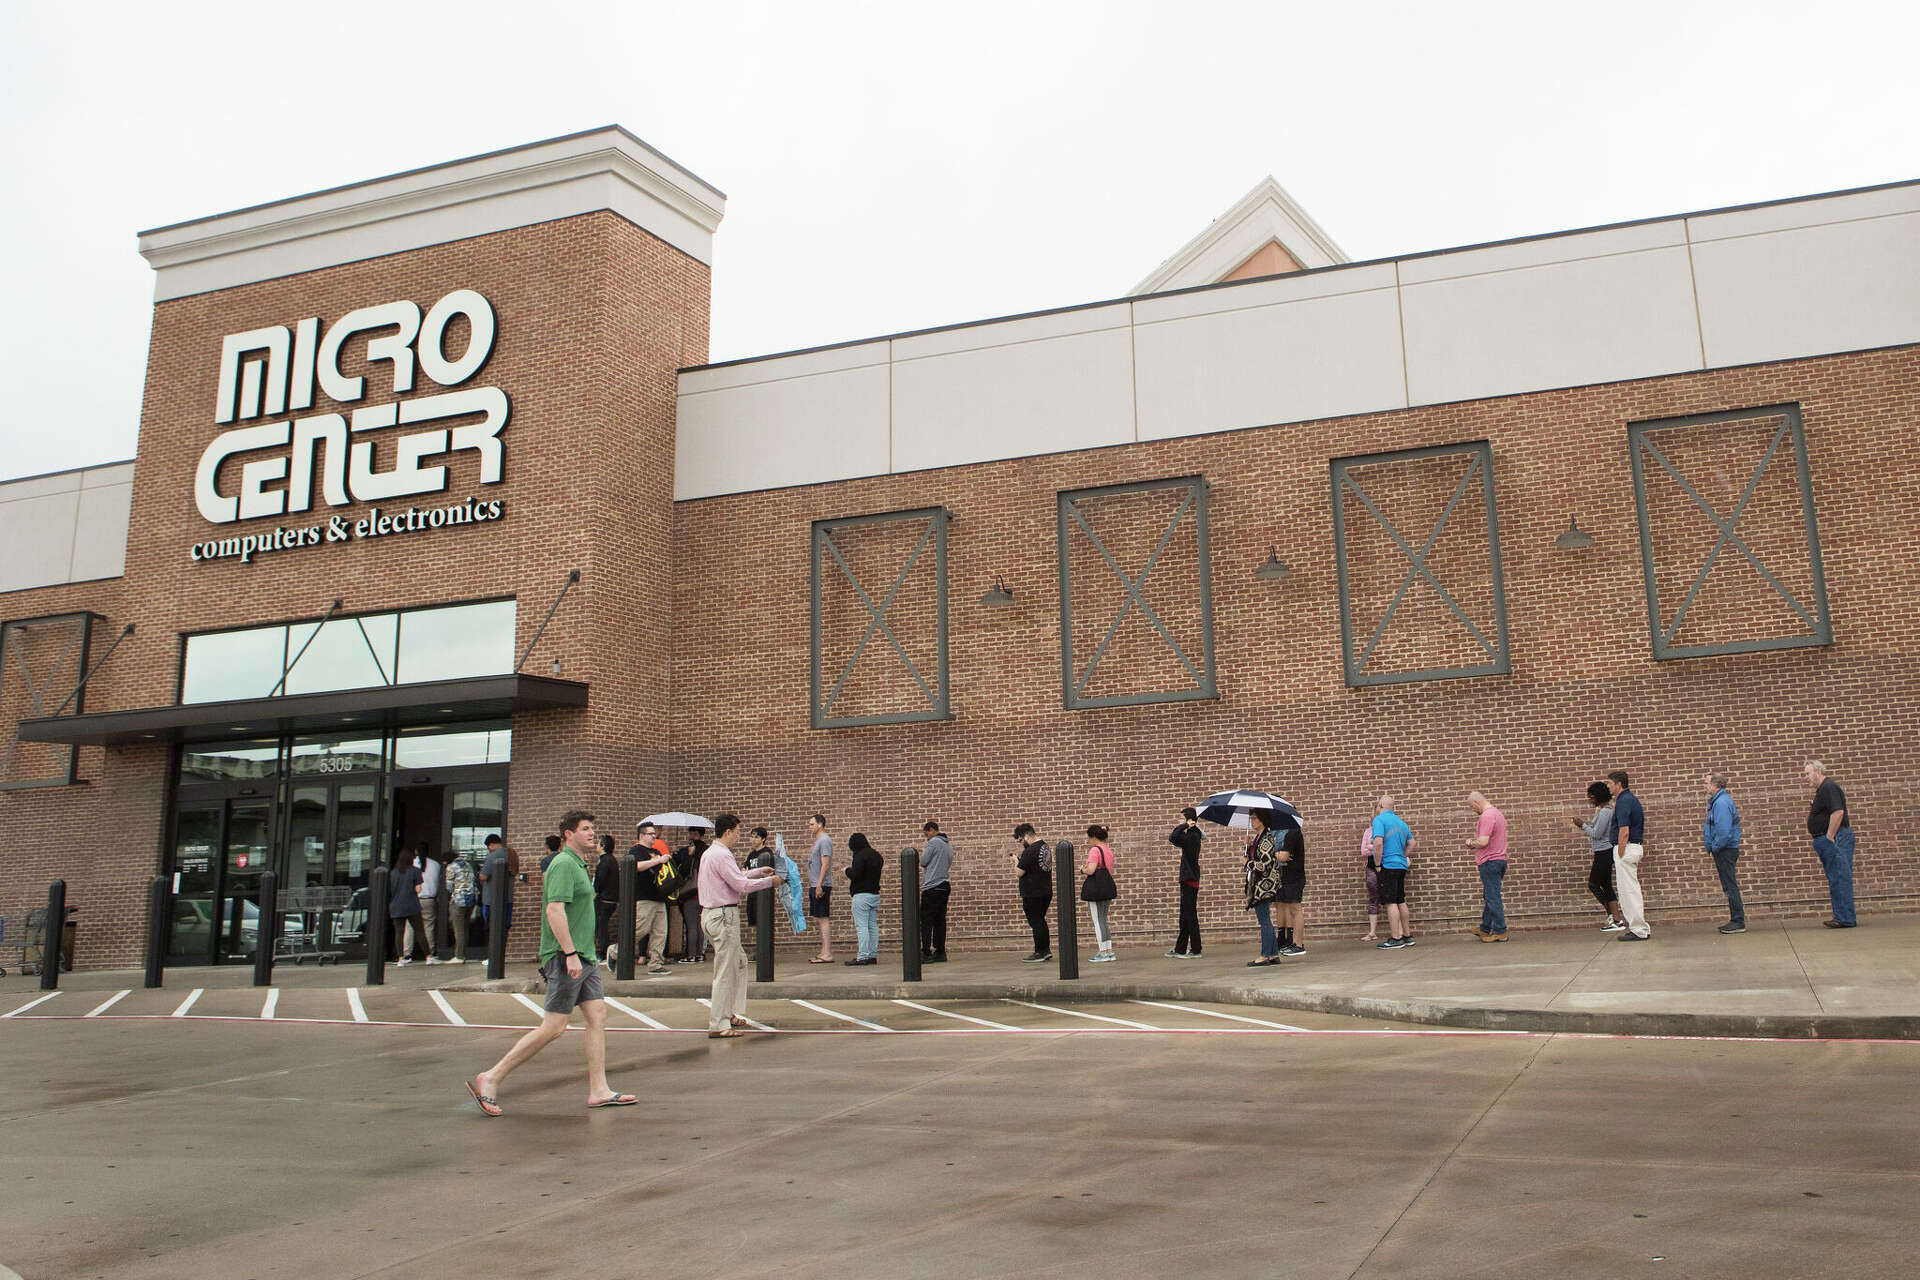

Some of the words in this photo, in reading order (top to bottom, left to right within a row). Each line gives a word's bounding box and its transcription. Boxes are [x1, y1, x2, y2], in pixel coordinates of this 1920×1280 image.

[215, 289, 495, 424] MICRO
[194, 386, 508, 523] CENTER
[191, 526, 321, 563] computers
[326, 515, 350, 542] &
[355, 496, 501, 538] electronics
[320, 757, 353, 773] 5305
